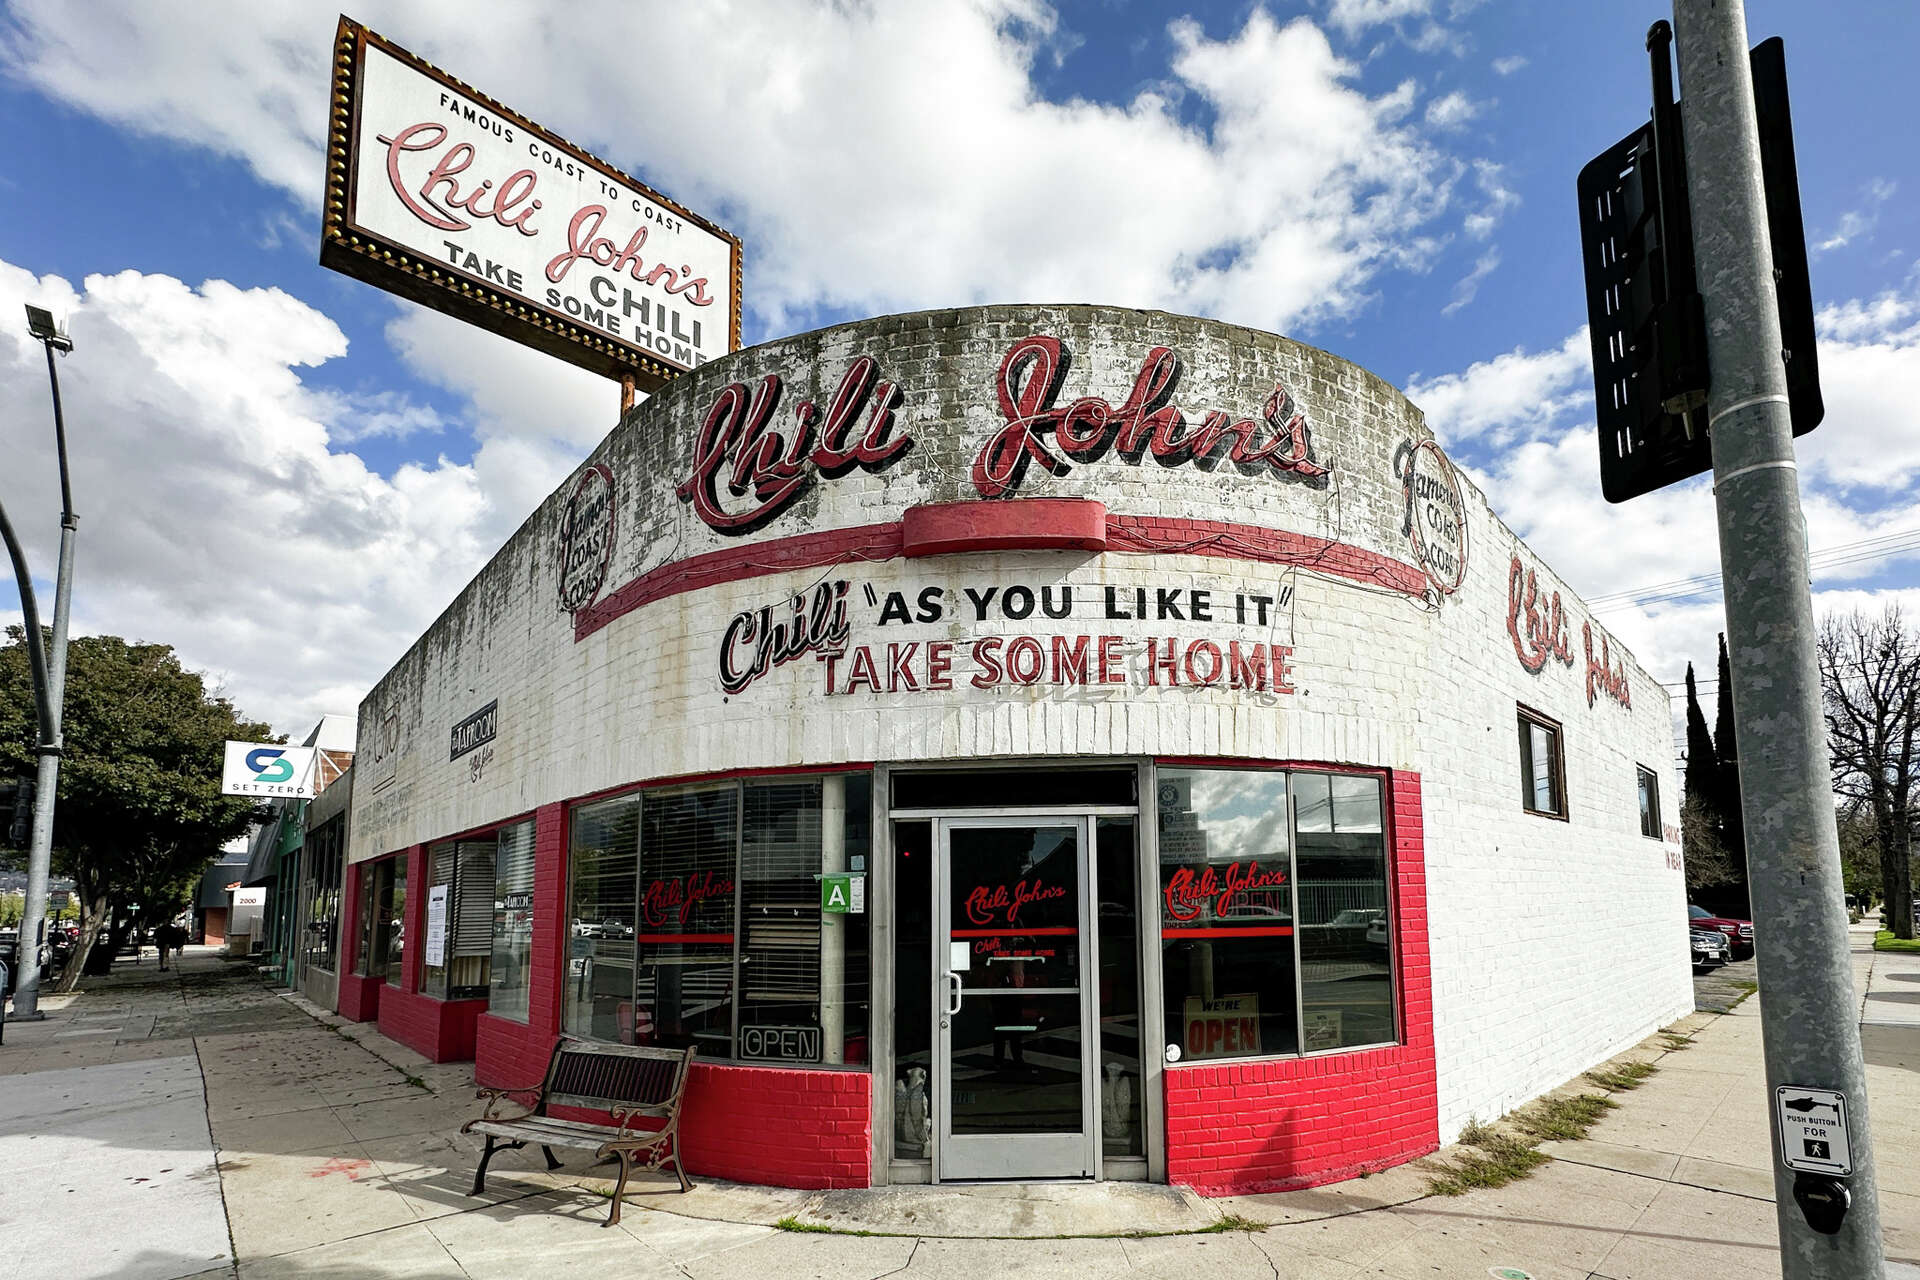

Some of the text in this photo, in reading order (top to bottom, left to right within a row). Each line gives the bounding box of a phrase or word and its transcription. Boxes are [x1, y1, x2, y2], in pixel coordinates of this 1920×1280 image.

[440, 93, 682, 235] FAMOUS COAST TO COAST
[377, 122, 714, 306] Chili John's
[443, 240, 523, 292] TAKE
[546, 288, 621, 335] SOME
[590, 275, 701, 348] CHILI
[677, 355, 915, 536] Chili
[1427, 503, 1460, 547] COAST
[965, 586, 1072, 621] YOU
[1105, 586, 1212, 623] LIKE
[1506, 557, 1574, 675] Chili
[718, 580, 852, 694] Chili
[817, 635, 1297, 695] TAKE SOME HOME
[457, 708, 496, 752] TAPROOM
[233, 784, 305, 794] SET ZERO
[644, 870, 735, 927] Chili John's
[828, 885, 846, 906] A
[964, 880, 1066, 925] Chili John's
[1163, 867, 1219, 921] Chili
[1216, 861, 1287, 917] John's
[975, 937, 1001, 954] Chili
[1202, 1000, 1241, 1012] WE'RE
[746, 1030, 814, 1058] OPEN
[1189, 1016, 1256, 1053] OPEN
[1787, 1115, 1837, 1126] PUSH BUTTON
[1803, 1127, 1827, 1138] FOR
